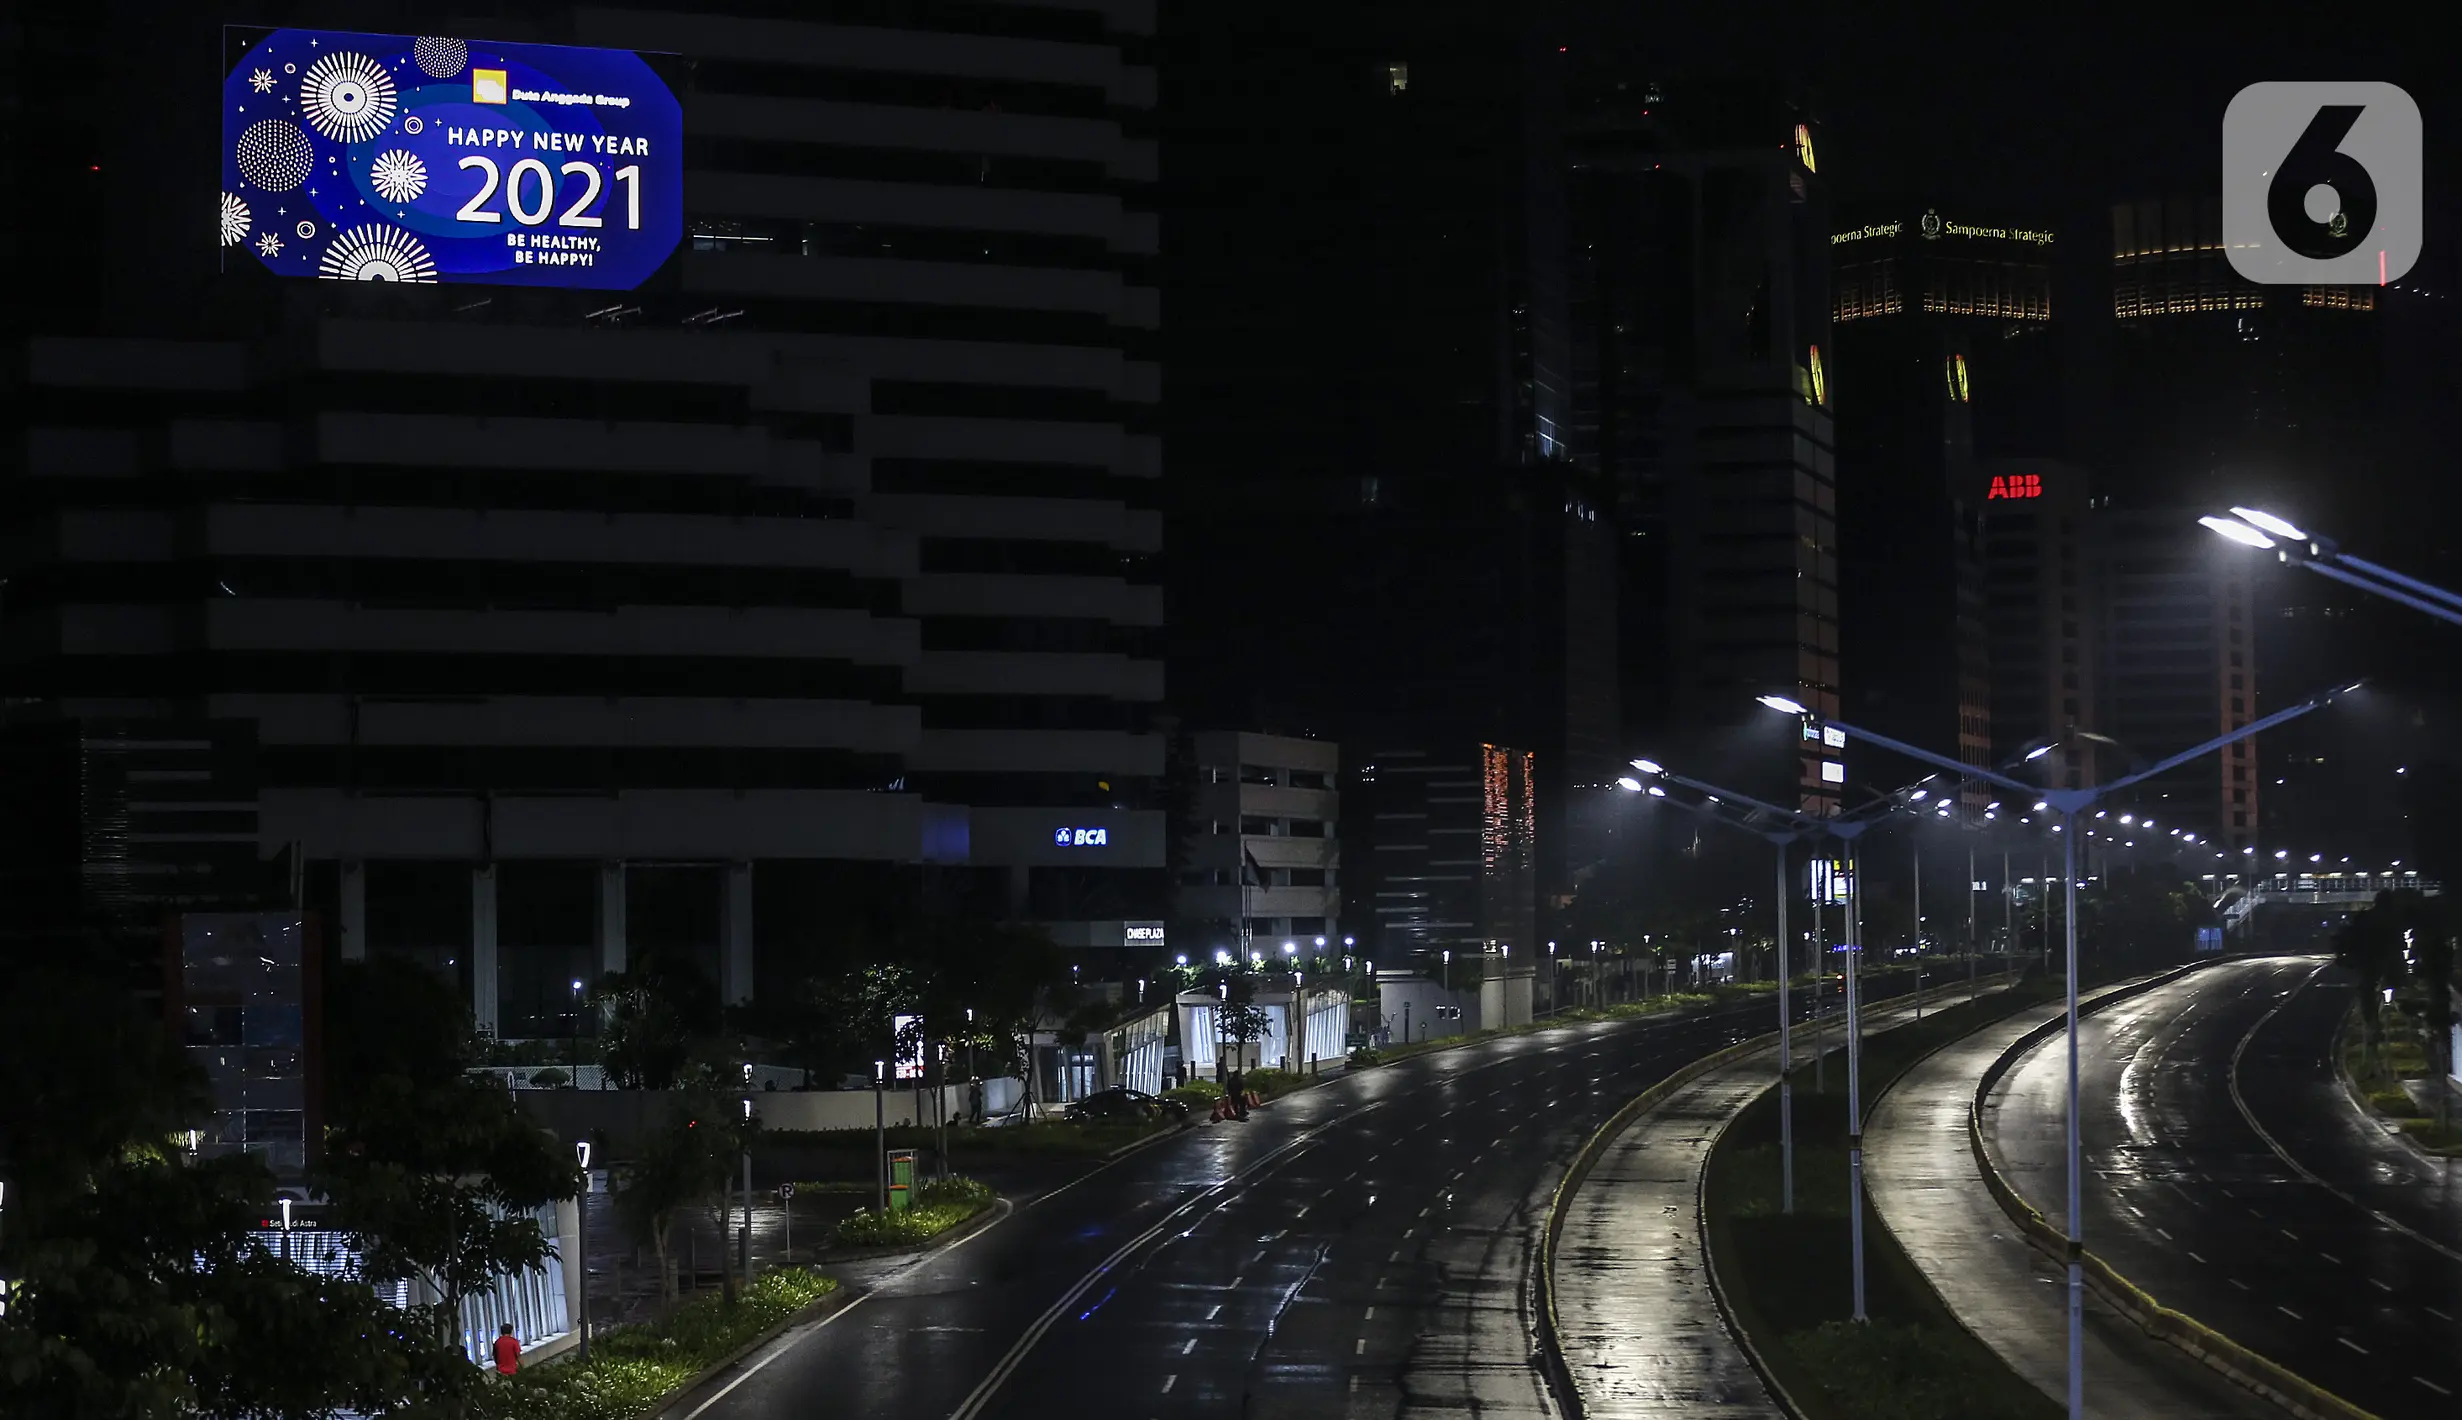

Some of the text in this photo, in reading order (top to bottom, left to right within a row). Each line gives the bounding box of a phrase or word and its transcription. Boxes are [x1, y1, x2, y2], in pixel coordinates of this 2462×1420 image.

[512, 89, 540, 101] Duta
[595, 94, 630, 108] Group
[448, 127, 649, 156] HAPPY NEW YEAR
[456, 155, 640, 230] 2021
[1864, 220, 1903, 239] Strategic
[1946, 221, 2055, 246] Sampoerna Strategic
[507, 234, 601, 252] BE HEALTHY,
[515, 251, 593, 267] BE HAPPY!
[1988, 474, 2043, 500] ABB
[1074, 829, 1107, 846] BCA
[1146, 927, 1164, 939] PLAZA
[300, 1220, 317, 1228] Astra
